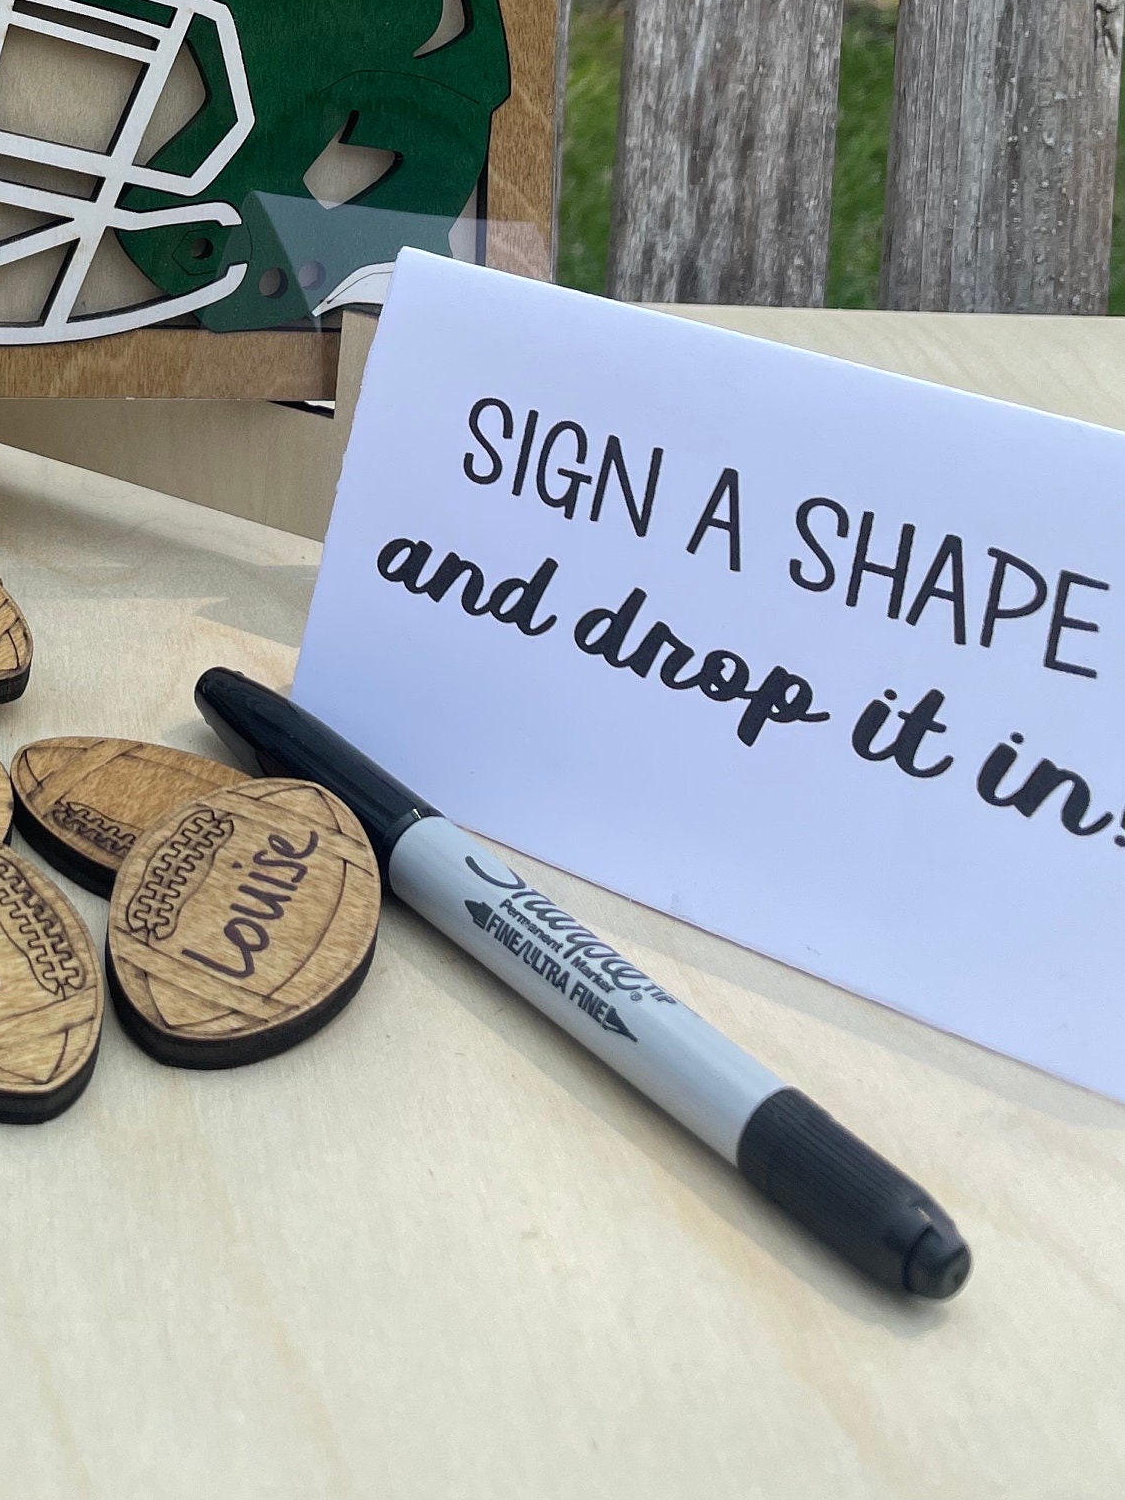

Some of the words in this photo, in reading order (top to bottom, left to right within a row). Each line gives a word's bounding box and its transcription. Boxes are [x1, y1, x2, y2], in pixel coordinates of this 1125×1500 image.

[463, 398, 664, 537] SIGN
[686, 467, 741, 571] A
[789, 497, 1110, 678] SHAPE
[376, 536, 559, 636] and
[574, 587, 830, 747] drop
[852, 688, 953, 779] it
[182, 830, 321, 981] Louise
[485, 914, 570, 995] FINE/ULTRA
[569, 982, 609, 1026] FINE
[499, 898, 565, 954] Permanent
[570, 957, 617, 994] Marker
